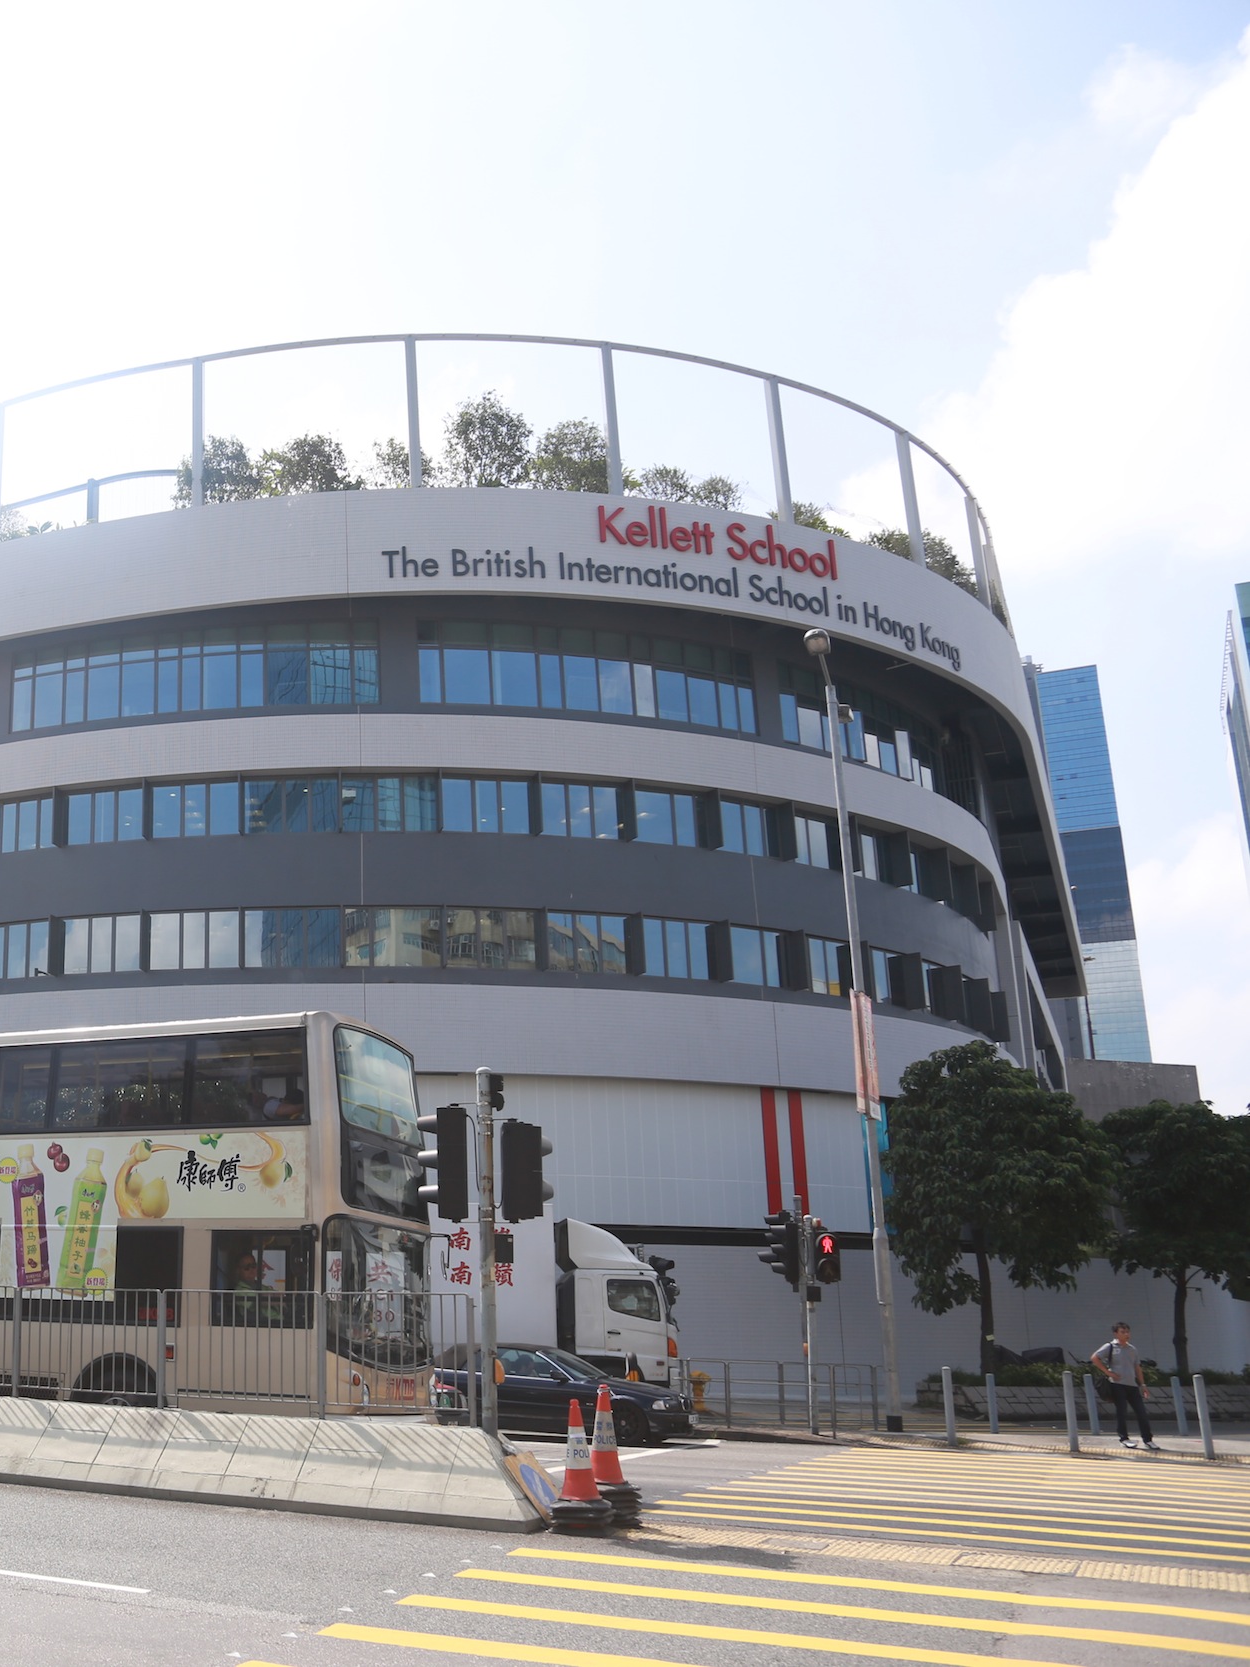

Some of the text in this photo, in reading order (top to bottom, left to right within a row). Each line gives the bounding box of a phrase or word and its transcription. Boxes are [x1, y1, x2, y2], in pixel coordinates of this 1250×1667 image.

[597, 504, 838, 581] Kellett School
[382, 545, 962, 671] The British International School in Hong Kong
[176, 1150, 241, 1192] 康師傅
